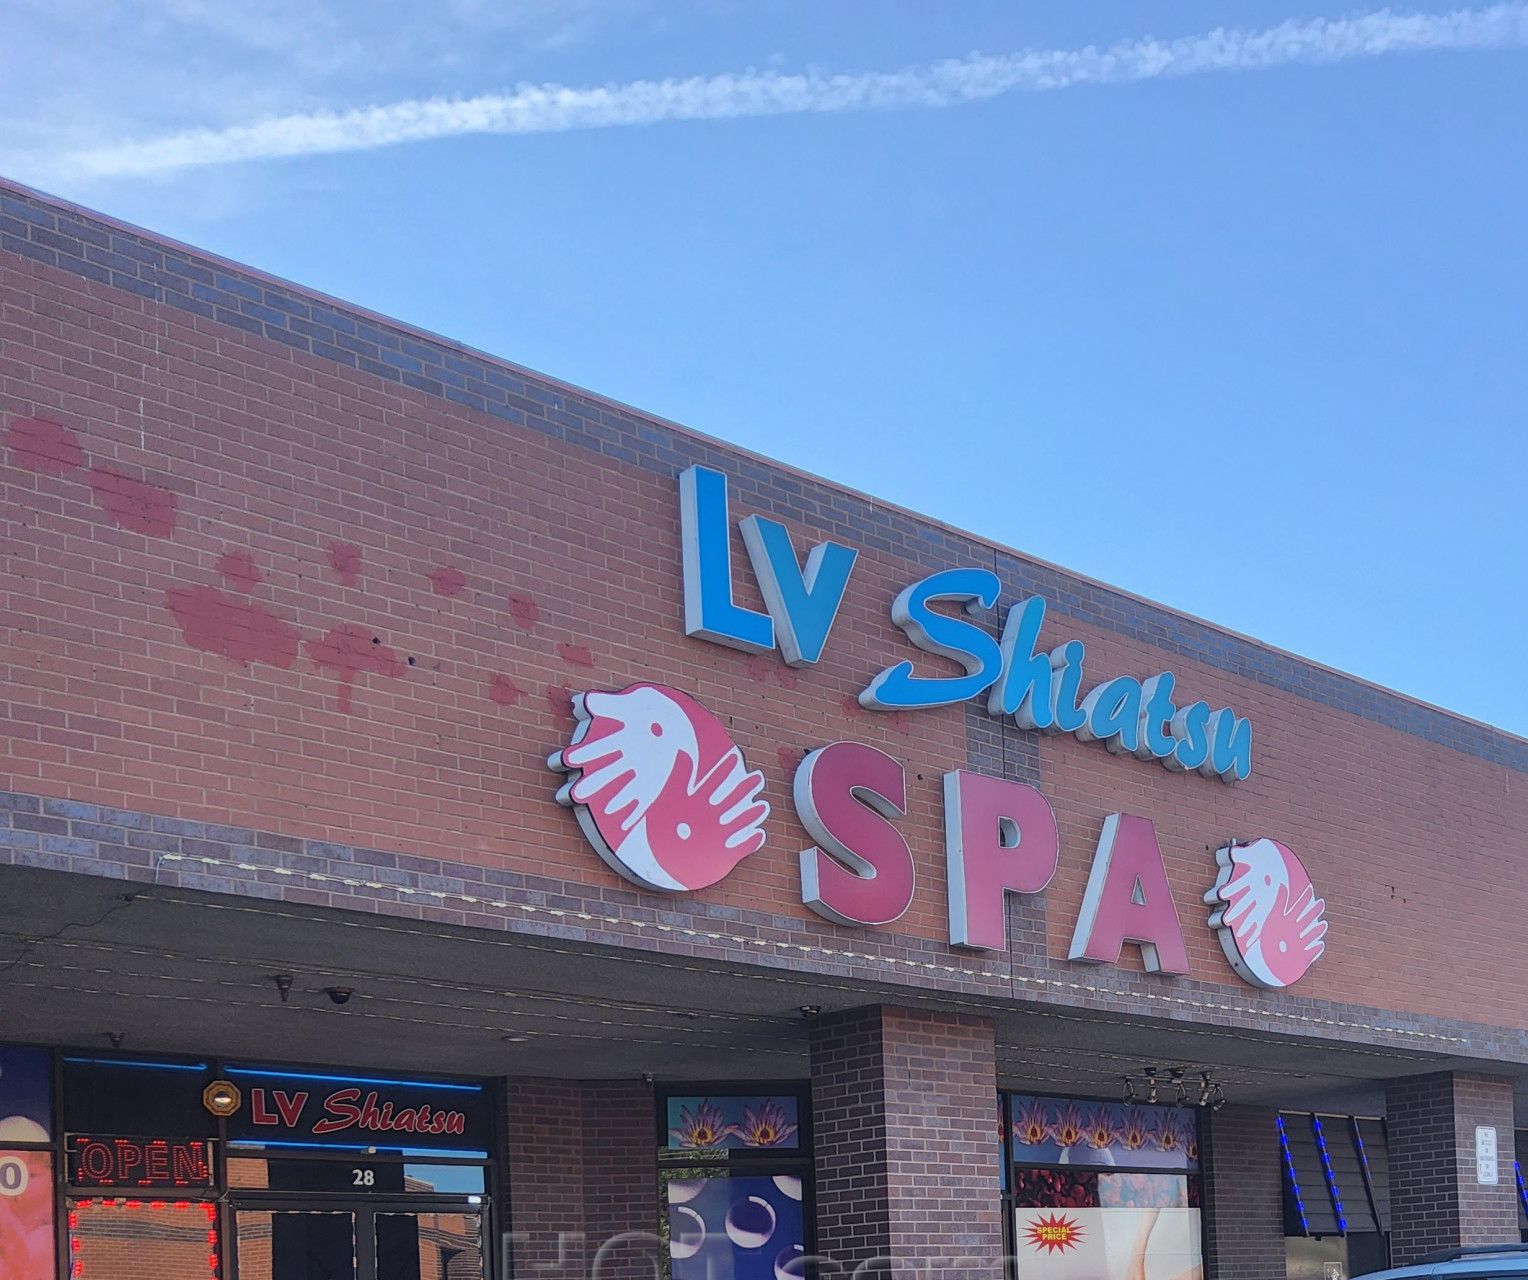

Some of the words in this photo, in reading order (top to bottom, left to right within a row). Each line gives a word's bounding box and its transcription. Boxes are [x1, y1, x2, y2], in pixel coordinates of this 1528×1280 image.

[680, 465, 858, 666] LV
[860, 568, 1252, 783] Shiatsu
[794, 741, 1190, 976] SPA
[252, 1088, 308, 1127] LV
[312, 1088, 465, 1134] Shiatsu
[82, 1143, 206, 1180] OPEN
[352, 1169, 375, 1185] 28
[1036, 1226, 1073, 1234] SPECIAL
[1042, 1233, 1067, 1241] PRICE
